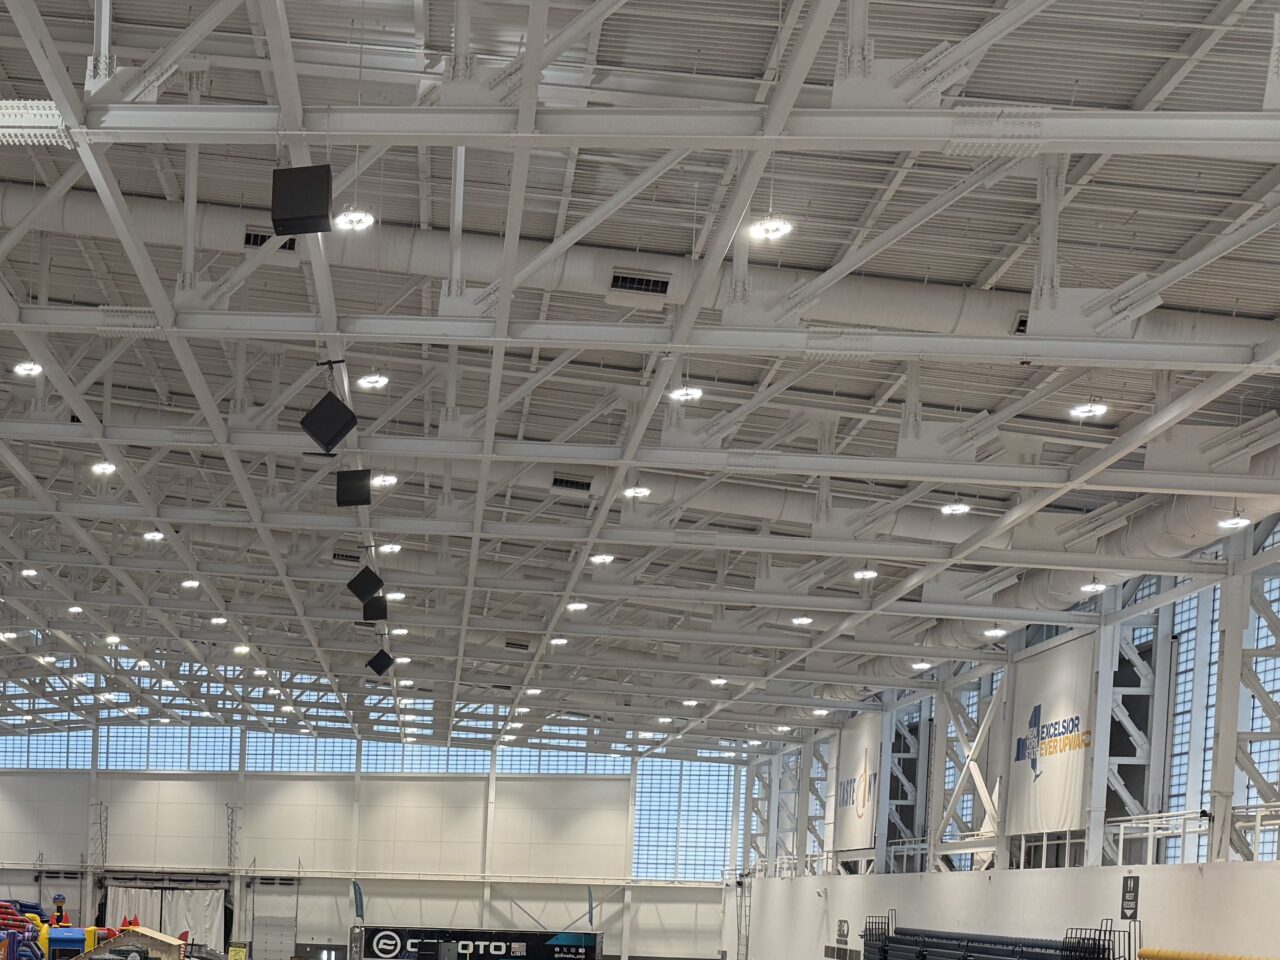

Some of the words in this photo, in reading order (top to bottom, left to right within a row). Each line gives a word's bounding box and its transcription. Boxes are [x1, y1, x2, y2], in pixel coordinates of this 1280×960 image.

[1040, 715, 1080, 741] EXCELSIOR
[1039, 738, 1059, 757] EVER
[1059, 730, 1092, 753] UPWARD
